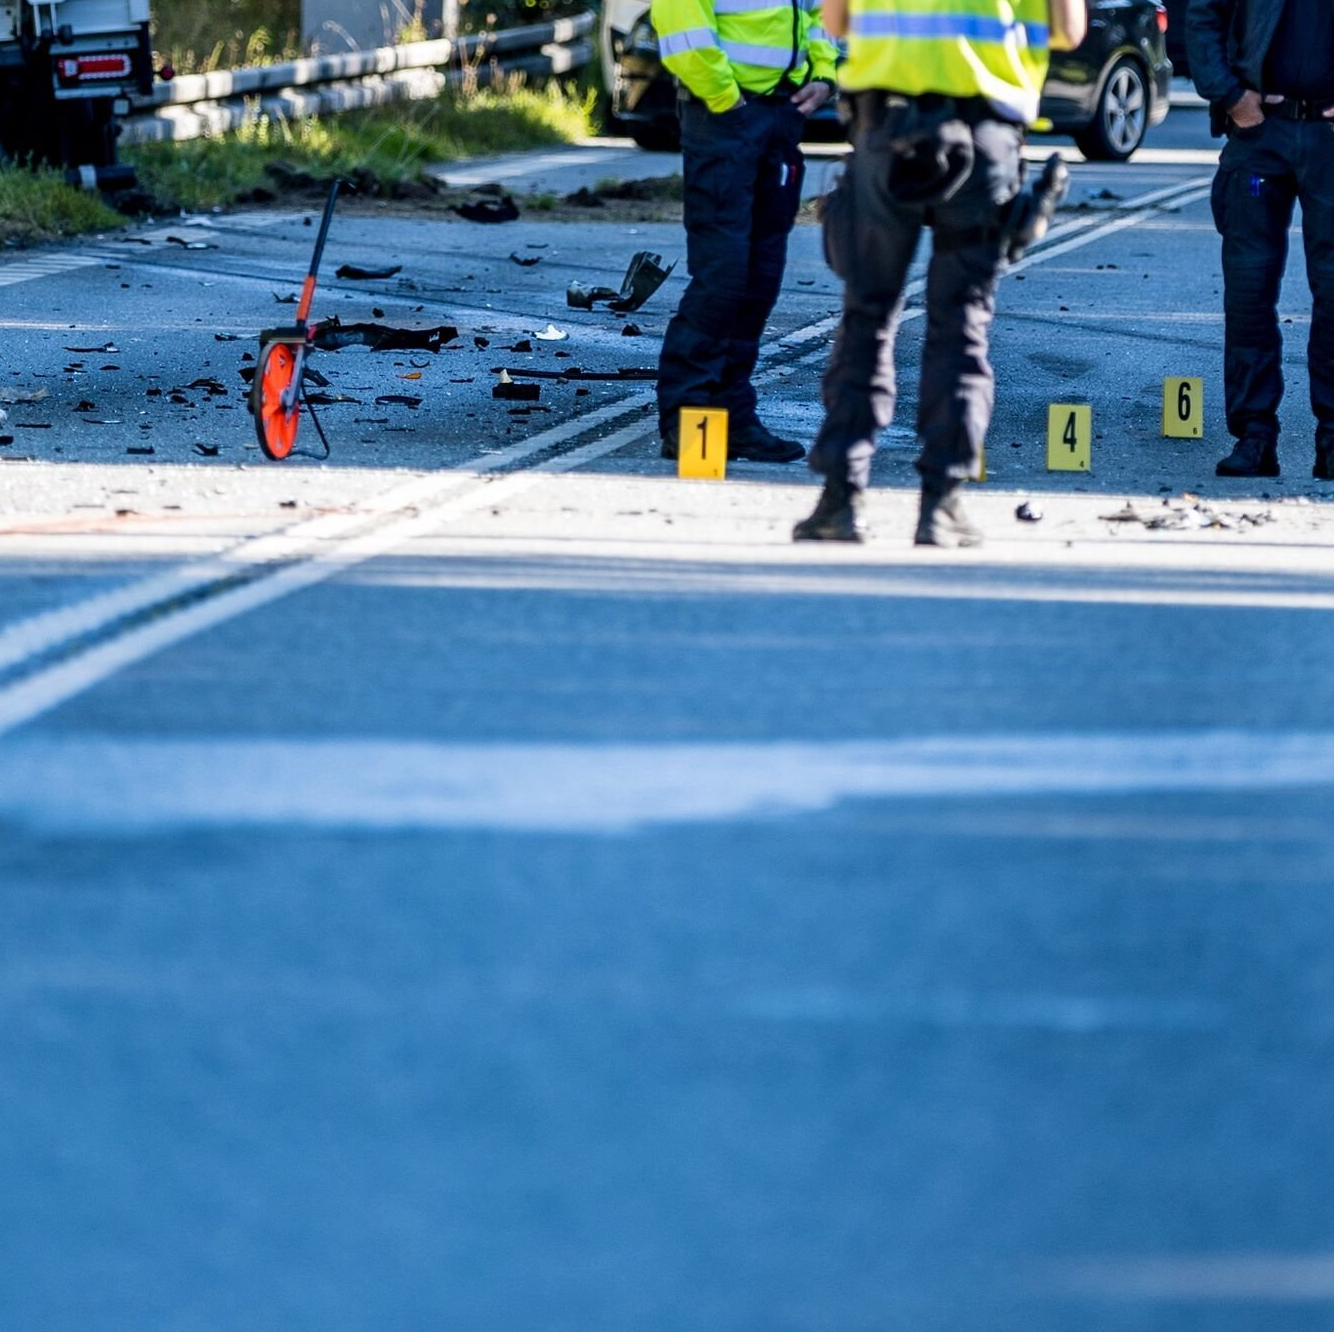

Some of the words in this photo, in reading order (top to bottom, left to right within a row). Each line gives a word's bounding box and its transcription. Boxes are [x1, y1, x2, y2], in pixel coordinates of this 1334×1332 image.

[1177, 381, 1191, 421] 6
[696, 416, 708, 460] 1
[1062, 411, 1077, 453] 4
[1192, 427, 1198, 435] 6
[1079, 460, 1084, 468] 4
